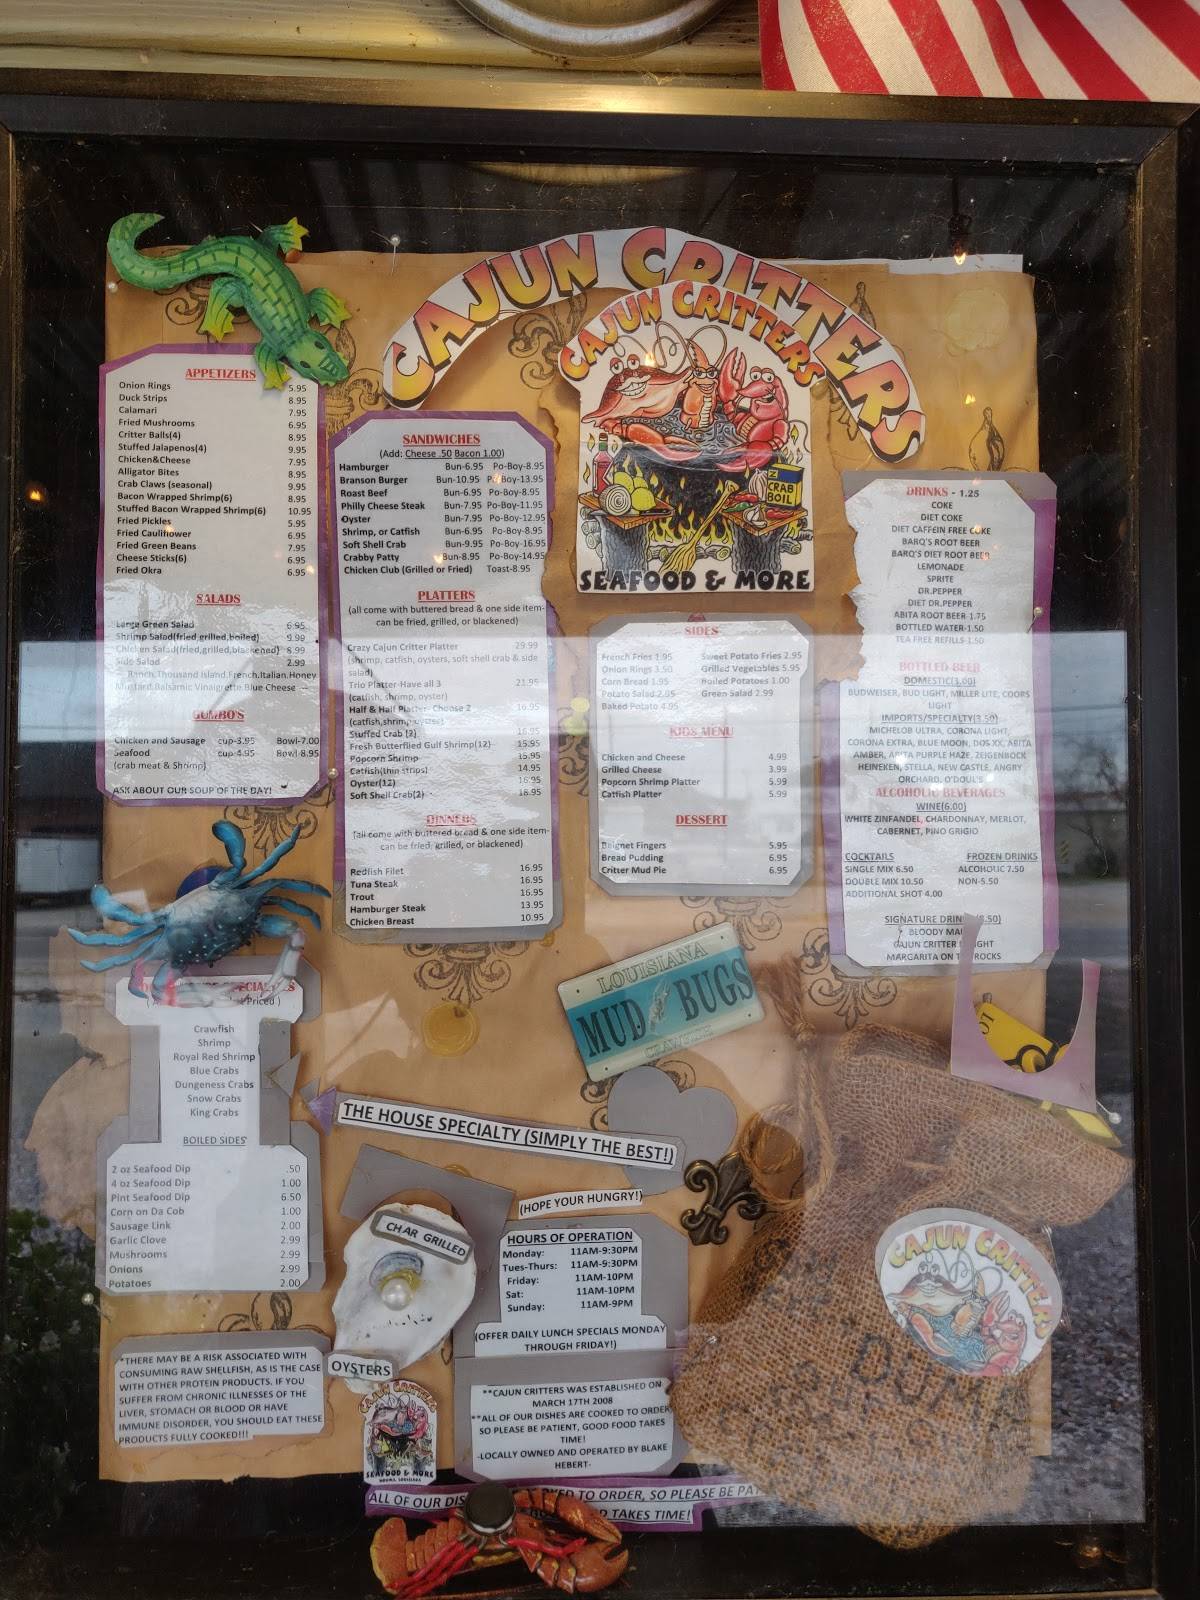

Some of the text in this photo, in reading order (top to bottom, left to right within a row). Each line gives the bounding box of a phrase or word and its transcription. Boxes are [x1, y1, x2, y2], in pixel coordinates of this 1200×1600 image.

[559, 283, 826, 387] CAJUN CRITTERS
[391, 228, 926, 458] CAJUN CRITTERS
[185, 369, 256, 379] APPETIZERS
[148, 382, 170, 391] Rings
[143, 394, 167, 403] Strips
[144, 419, 195, 427] Mushrooms
[149, 431, 181, 440] Balls(4)
[403, 434, 480, 444] SANDWICHES
[118, 456, 191, 464] Chicken&Cheese
[340, 462, 544, 472] Hamburger Bun-6.95 Po-Boy-8.95
[118, 469, 155, 478] Alligator
[767, 481, 794, 494] CRAB
[368, 489, 387, 497] Beef
[489, 489, 540, 497] Po-Boy-8.95
[767, 492, 793, 504] BOIL
[341, 502, 365, 512] Philly
[368, 502, 398, 510] Cheese
[401, 502, 425, 510] Steak
[487, 501, 543, 510] Po-Boy-11.95
[341, 516, 370, 525] Oyster
[490, 514, 545, 523] Po-Boy-12.95
[117, 542, 138, 550] Fried
[961, 539, 979, 547] BEER
[150, 554, 186, 563] Sticks(6)
[580, 570, 810, 592] SEAFOOD & MORE
[196, 594, 240, 603] SALADS
[418, 591, 475, 600] PLATTERS
[602, 778, 636, 787] Popcorn
[639, 778, 668, 787] Shrimp
[672, 778, 700, 786] Platter
[676, 815, 728, 824] DESSERT
[602, 854, 626, 862] Bread
[629, 854, 664, 863] Pudding
[845, 853, 895, 861] COCKTAILS
[521, 876, 543, 884] 16.95
[350, 901, 543, 914] Hamburger Steak 13.95
[350, 918, 386, 926] Chicken
[389, 917, 414, 925] Breast
[597, 943, 708, 994] LOUISIANA
[576, 999, 647, 1057] MUD
[673, 957, 755, 1021] BUGS
[198, 1039, 230, 1049] Shrimp
[174, 1053, 255, 1063] Royal Red Shrimp
[214, 1067, 239, 1075] Crabs
[343, 1102, 674, 1164] THE HOUSE SPECIALTY (SIMPLY THE BEST!)
[183, 1136, 216, 1145] BOILED
[519, 1191, 643, 1215] (HOPE YOUR HUNGRY!)
[110, 1222, 300, 1231] Sausage Link 2.00
[386, 1222, 465, 1256] CHAR GRILLED
[508, 1232, 633, 1244] HOURS OF OPERATION
[503, 1246, 638, 1260] Monday: 11AM-9:30PM
[109, 1265, 300, 1274] Onions 2.99
[109, 1279, 300, 1288] Potatoes 2.00
[508, 1273, 633, 1286] Friday: 11AM-10PM
[889, 1225, 1053, 1339] CAJUN CRITTERS
[508, 1300, 633, 1314] Sunday: 11AM-9PM
[332, 1360, 391, 1376] OYSTERS
[532, 1399, 566, 1407] MARCH
[569, 1398, 590, 1406] 17TH
[119, 1431, 248, 1445] PRODUCTS FULLY COOKED!!!
[578, 1489, 596, 1500] TO
[600, 1488, 645, 1502] ORDER,
[649, 1487, 667, 1499] SO
[670, 1486, 715, 1499] PLEASE
[718, 1486, 734, 1497] BE
[612, 1508, 691, 1520] TAKES TIME!
